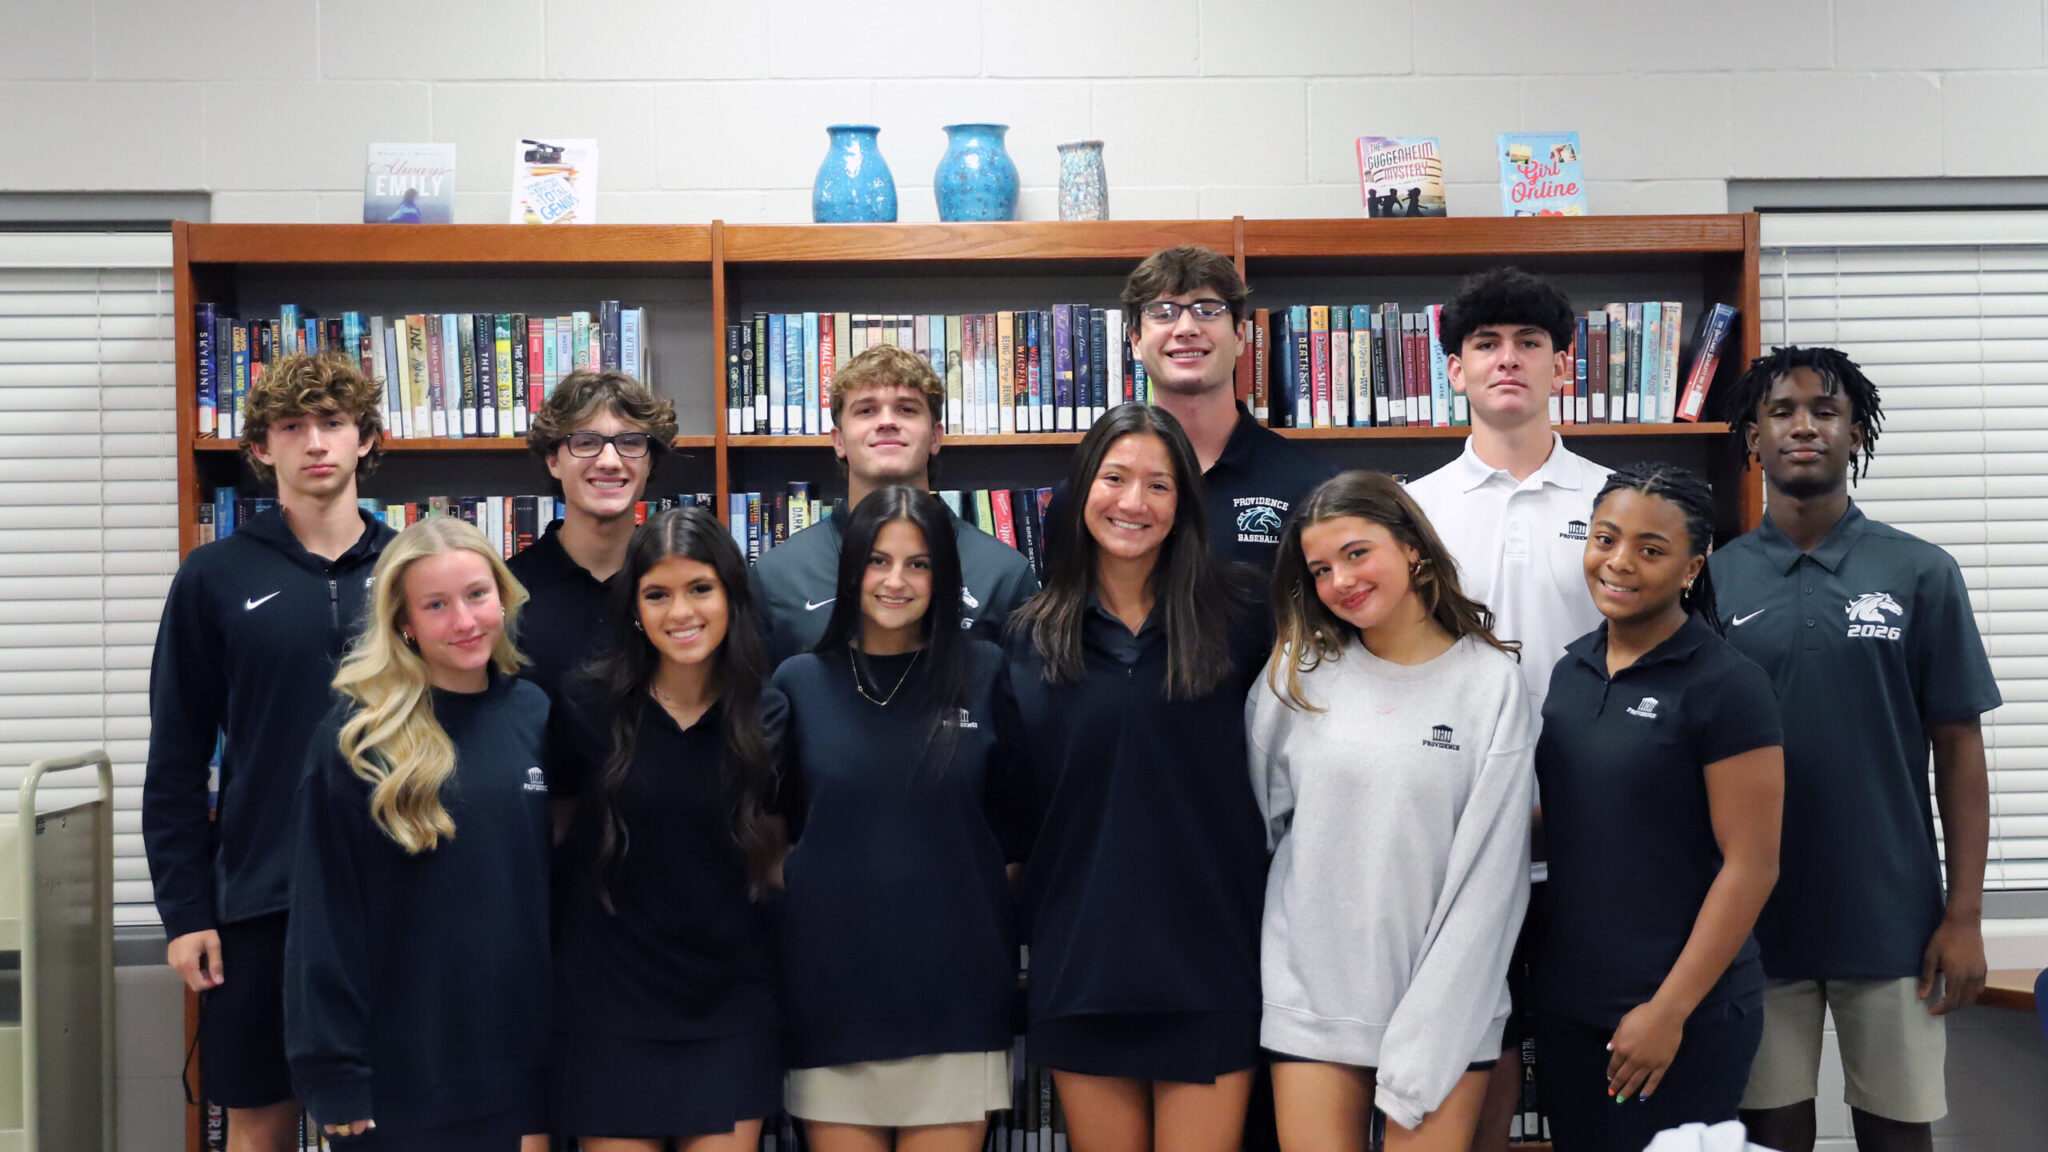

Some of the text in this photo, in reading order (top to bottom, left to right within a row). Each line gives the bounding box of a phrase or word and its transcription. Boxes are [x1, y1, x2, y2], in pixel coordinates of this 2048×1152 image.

[1367, 142, 1433, 170] GUGGENHEIM
[1383, 161, 1428, 181] MYSTERY
[1517, 160, 1560, 185] Girl
[375, 175, 443, 196] EMILY
[1512, 181, 1579, 203] Online
[272, 324, 280, 342] MIKE
[408, 326, 423, 351] INK
[1255, 326, 1263, 348] JOHN
[514, 344, 523, 358] THIS
[822, 343, 832, 366] HALL
[1001, 336, 1011, 354] BEING
[1298, 337, 1308, 370] DEATH
[1434, 344, 1443, 364] SCARS
[480, 352, 490, 372] THE
[1029, 346, 1039, 368] WILD
[730, 367, 739, 388] GODS
[1000, 358, 1012, 382] Mary
[1016, 346, 1026, 390] WILDFIRE
[514, 361, 524, 398] APPEARING
[1030, 370, 1039, 396] RIVER
[1135, 364, 1144, 401] THE MOON
[1299, 372, 1309, 392] Sets
[1233, 497, 1289, 511] PROVIDENCE
[792, 508, 804, 530] DARK
[750, 526, 758, 538] THE
[1238, 534, 1279, 543] BASEBALL
[1847, 624, 1901, 640] 2026
[1422, 739, 1460, 751] PROVIDENCE
